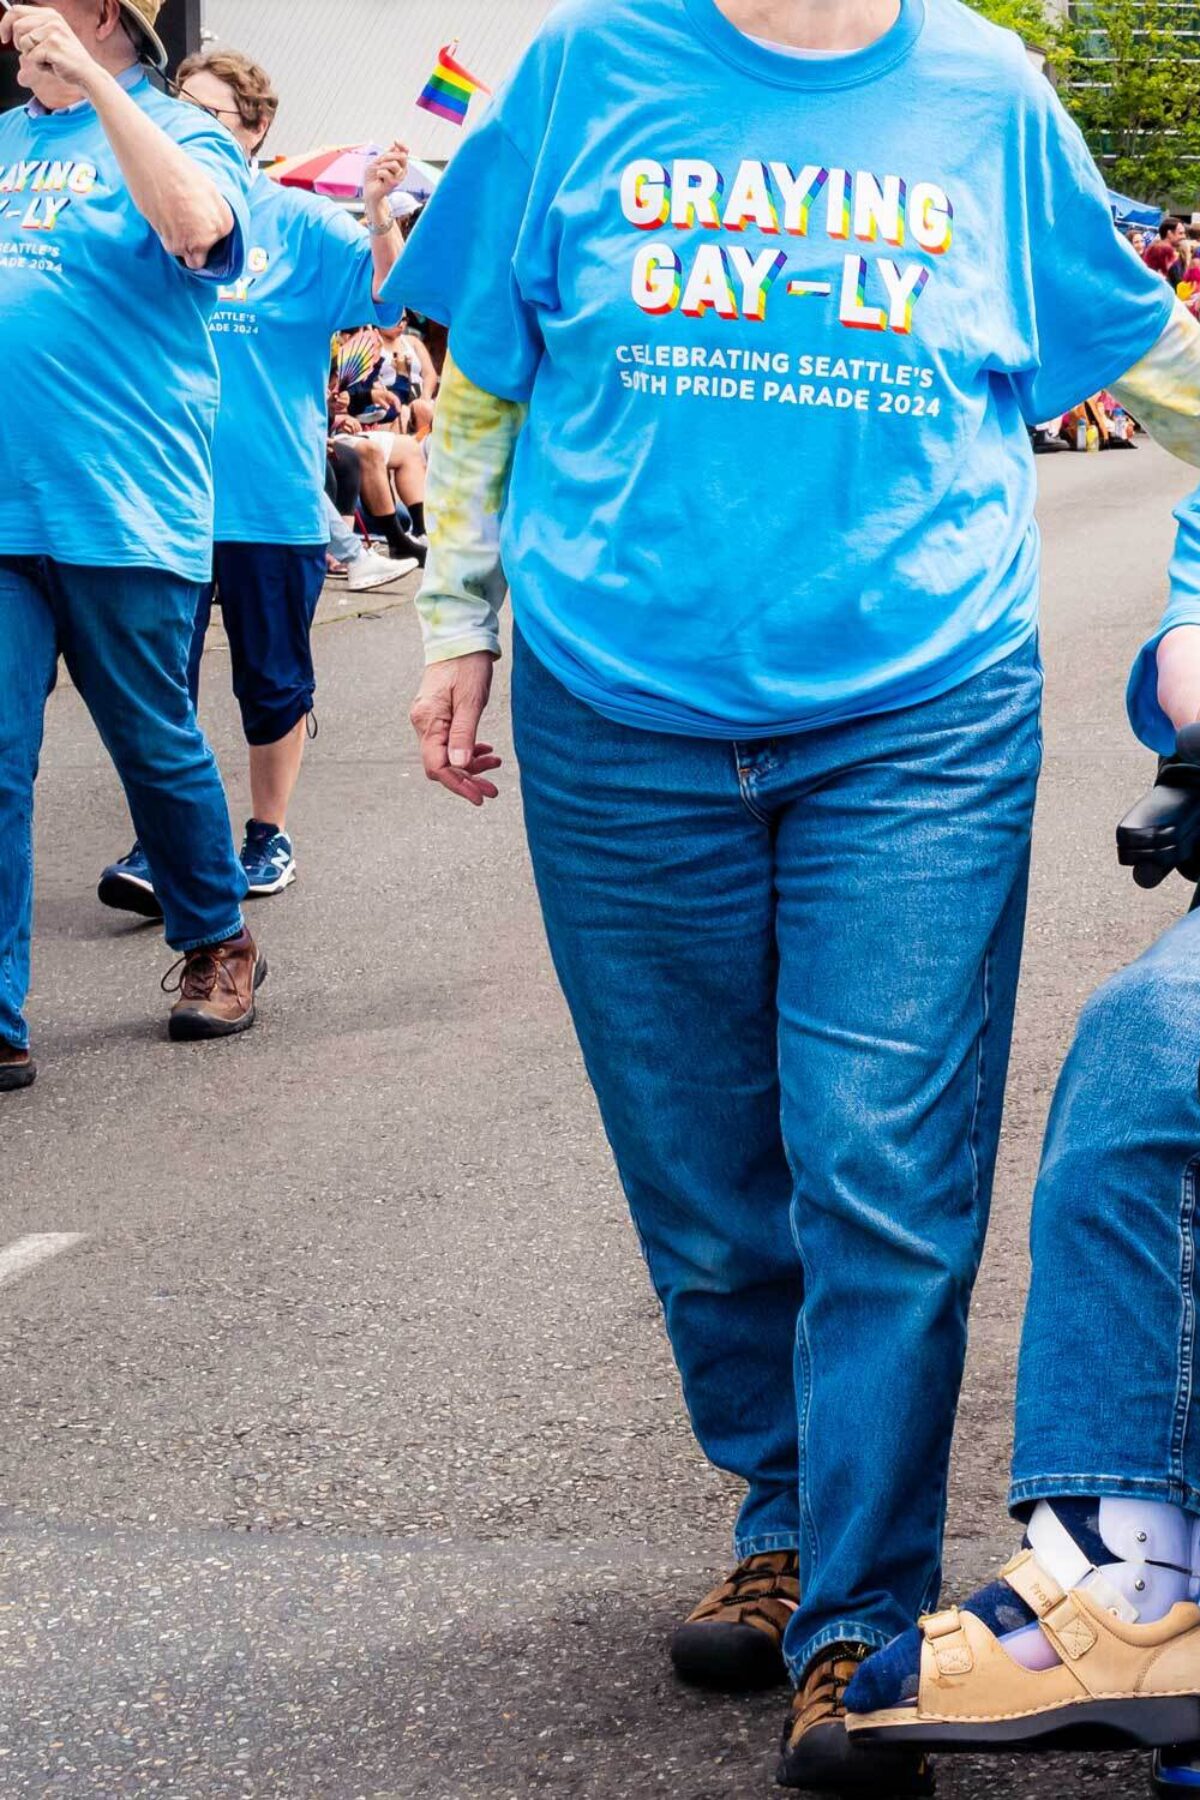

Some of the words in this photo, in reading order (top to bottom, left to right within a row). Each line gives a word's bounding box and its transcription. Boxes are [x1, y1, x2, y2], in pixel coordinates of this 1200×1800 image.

[620, 159, 954, 255] GRAYING
[0, 242, 60, 257] EATTLE'S
[28, 258, 63, 272] 2024
[631, 243, 929, 334] GAY-LY
[233, 324, 259, 335] 2024
[616, 344, 789, 374] CELEBRATING
[798, 355, 934, 388] SEATTLE'S
[620, 370, 667, 396] 50TH
[676, 375, 755, 401] PRIDE
[763, 381, 870, 411] PARADE
[877, 392, 940, 418] 2024
